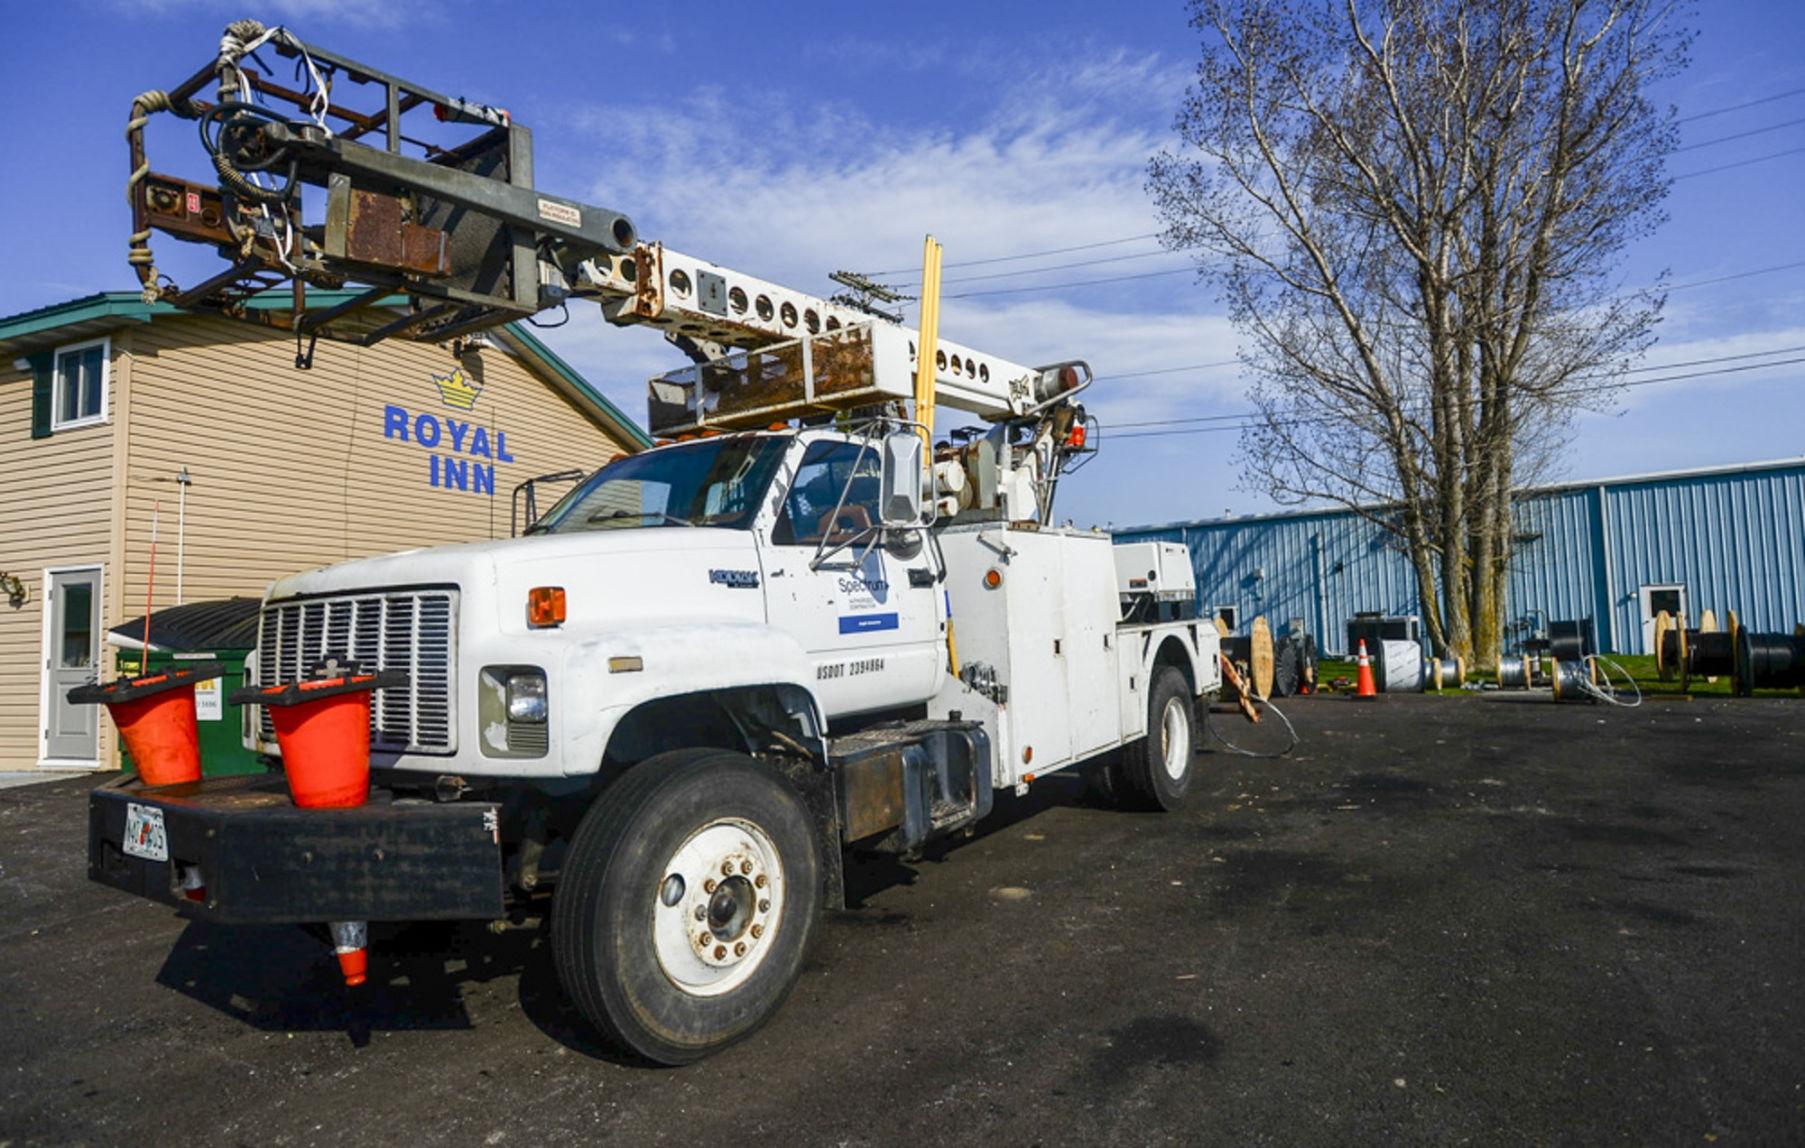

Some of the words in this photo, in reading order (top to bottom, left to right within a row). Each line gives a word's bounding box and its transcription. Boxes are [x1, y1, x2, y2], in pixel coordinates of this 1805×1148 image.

[384, 404, 514, 463] ROYAL
[429, 454, 494, 496] INN
[838, 577, 886, 595] Spectrum
[817, 664, 844, 680] USDOT
